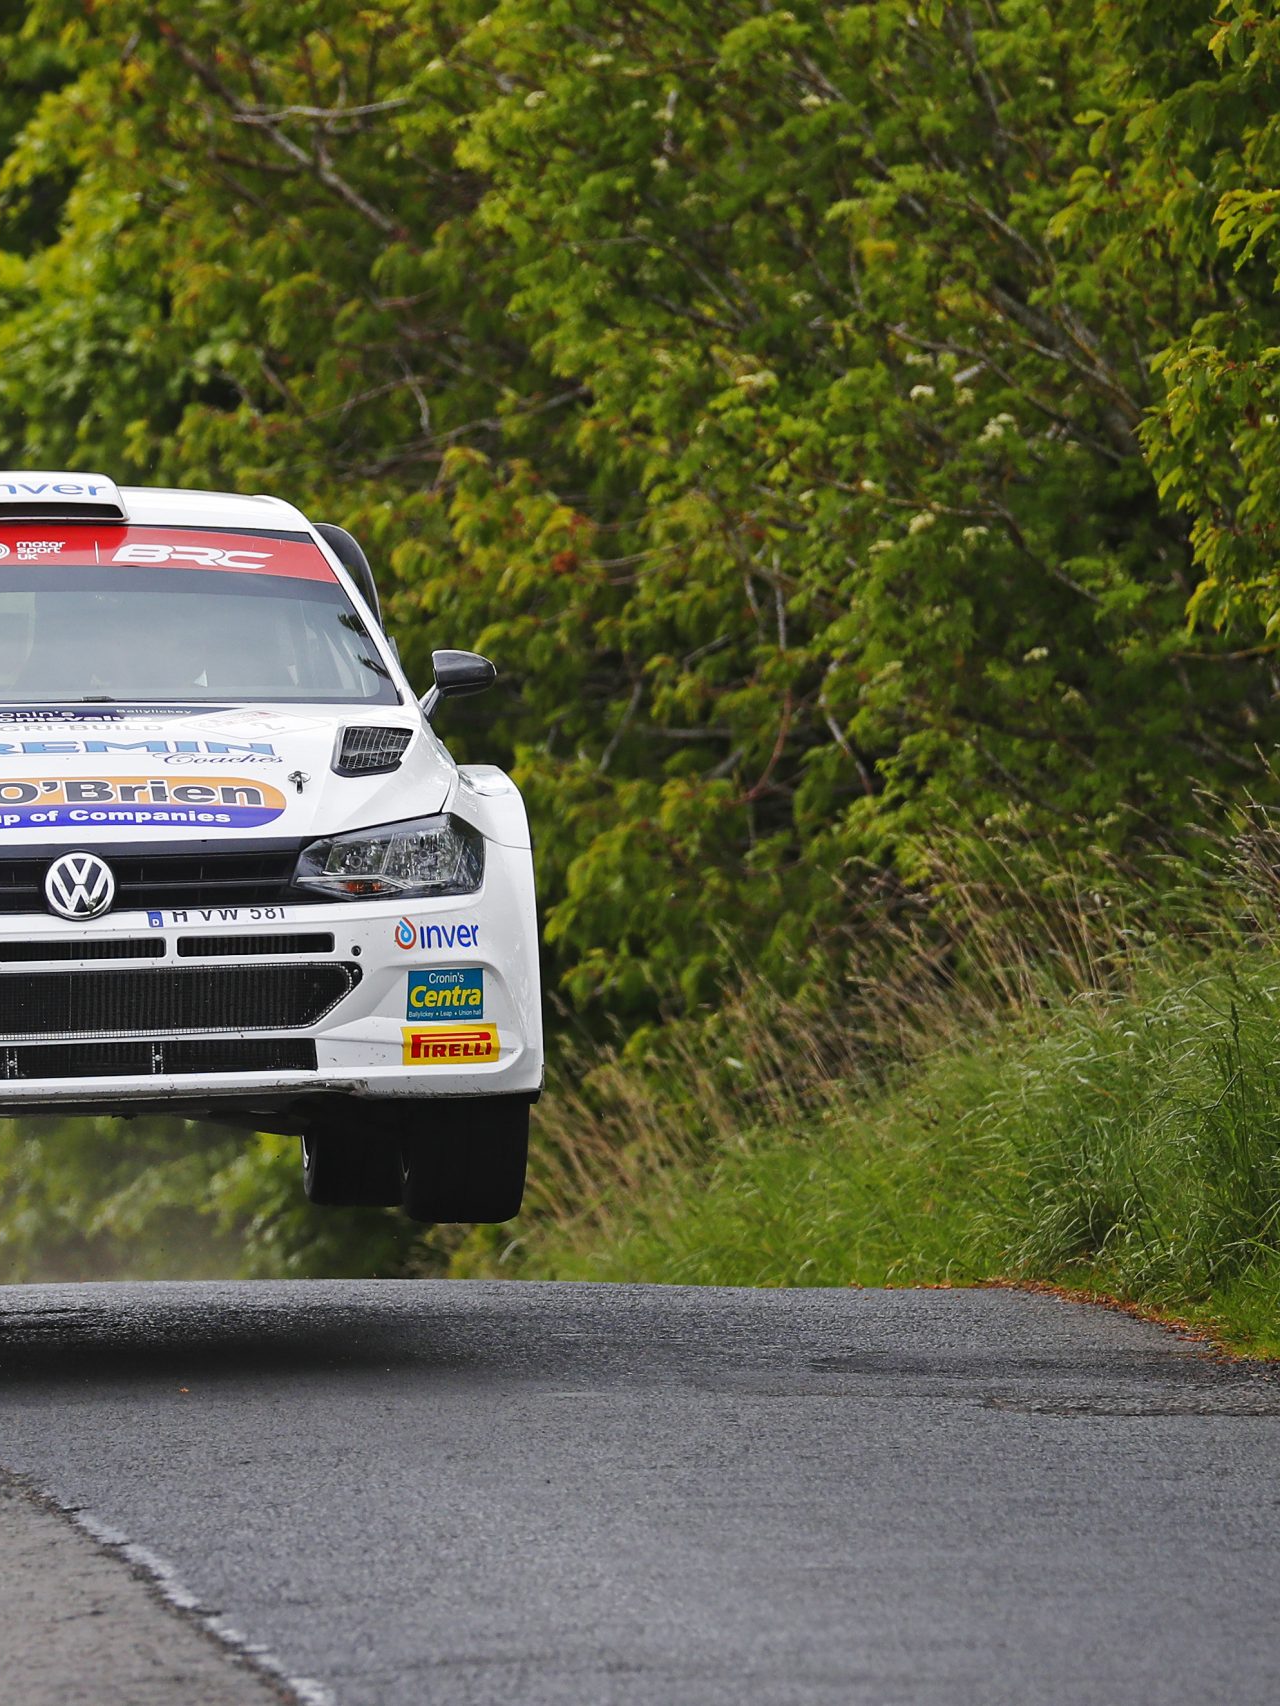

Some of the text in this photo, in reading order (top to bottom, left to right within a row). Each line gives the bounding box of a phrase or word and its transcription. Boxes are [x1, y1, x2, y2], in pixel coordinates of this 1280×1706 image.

[16, 547, 61, 555] sport
[112, 543, 273, 569] BRC
[153, 752, 283, 765] Coaches
[29, 810, 59, 822] of
[69, 809, 232, 823] Companies
[420, 924, 479, 949] inver
[429, 972, 464, 984] Cronin's
[410, 985, 481, 1008] Centra
[411, 1032, 492, 1058] PIRELLI
